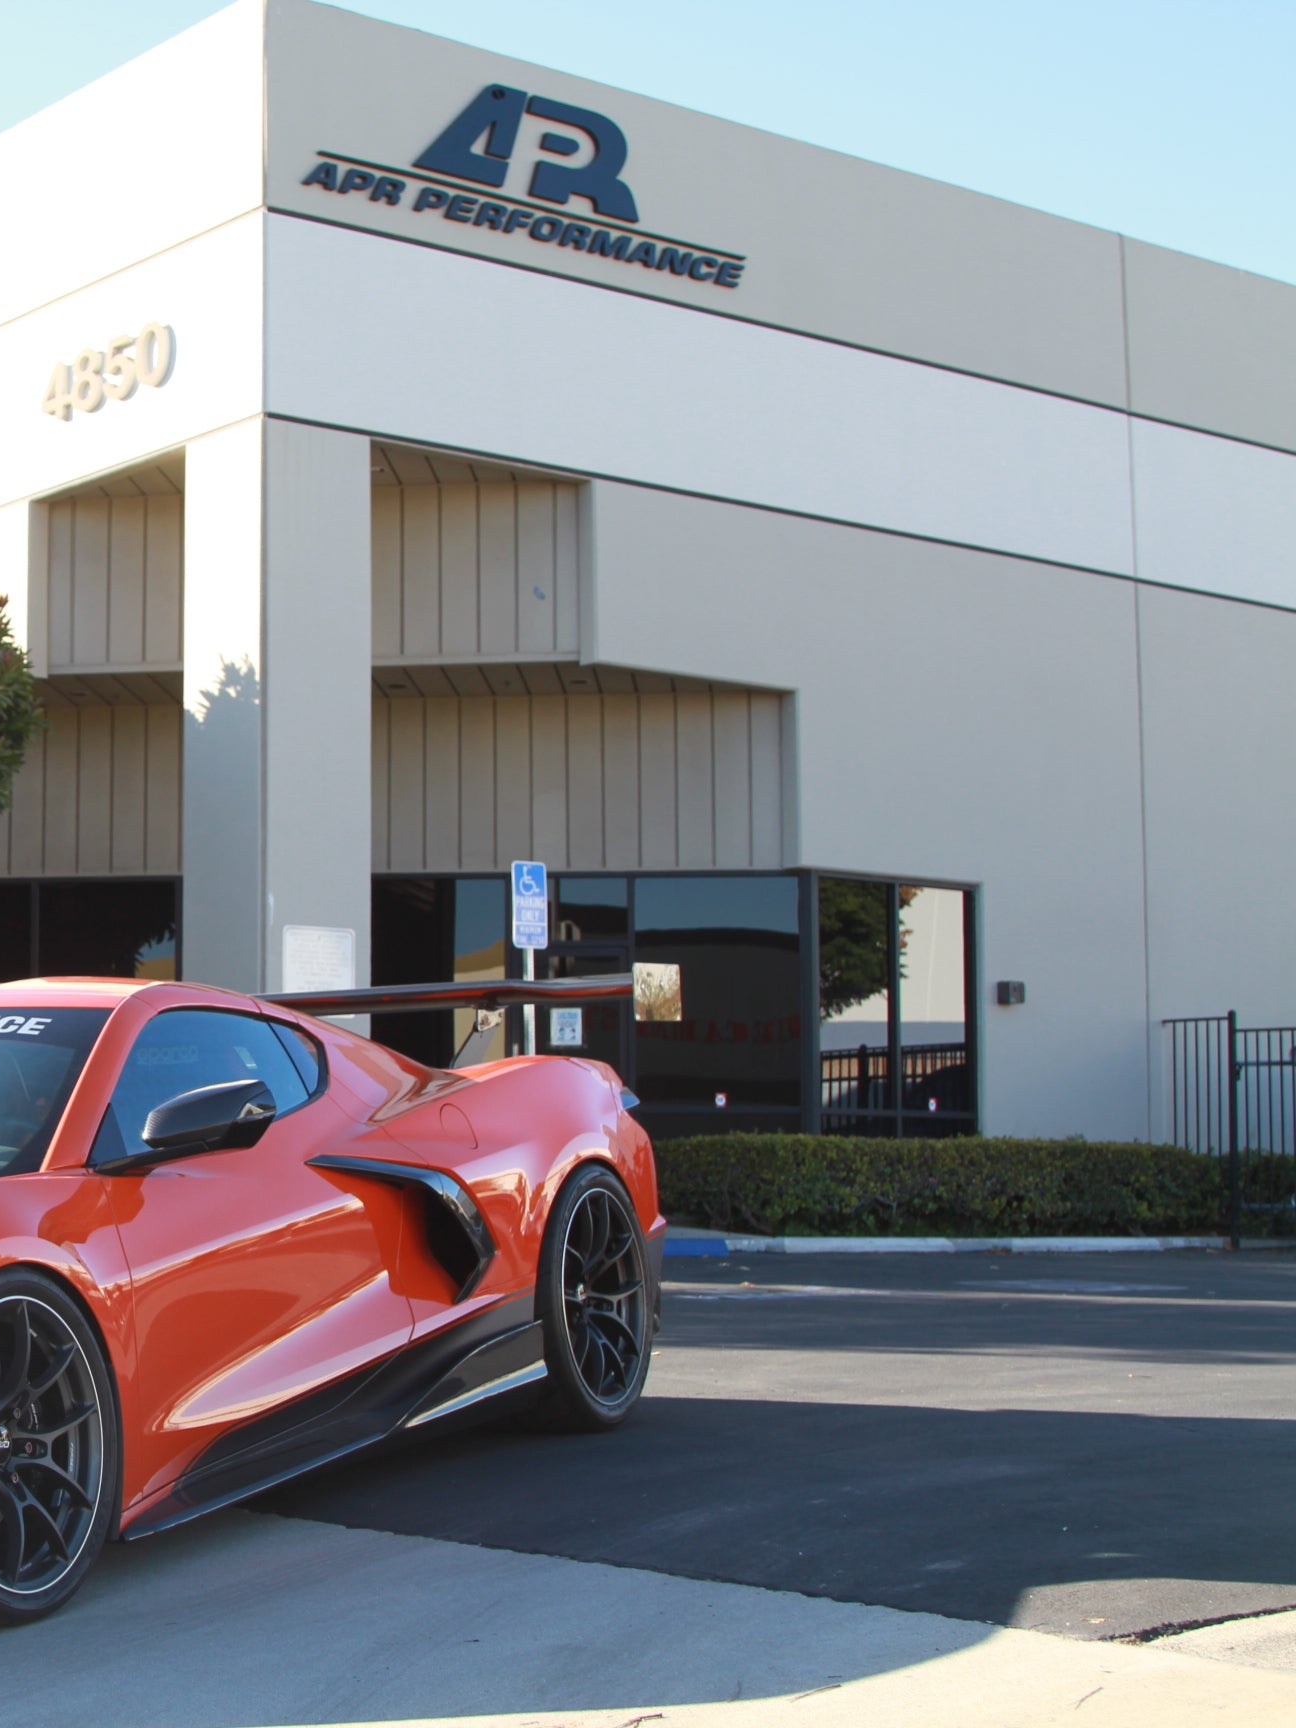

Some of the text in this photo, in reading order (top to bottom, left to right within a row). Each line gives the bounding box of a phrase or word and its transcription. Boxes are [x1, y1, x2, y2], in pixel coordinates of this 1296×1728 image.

[300, 161, 746, 289] APR PERFORMANCE
[42, 321, 176, 422] 4850
[516, 896, 545, 909] PARKING
[520, 909, 540, 921] ONLY
